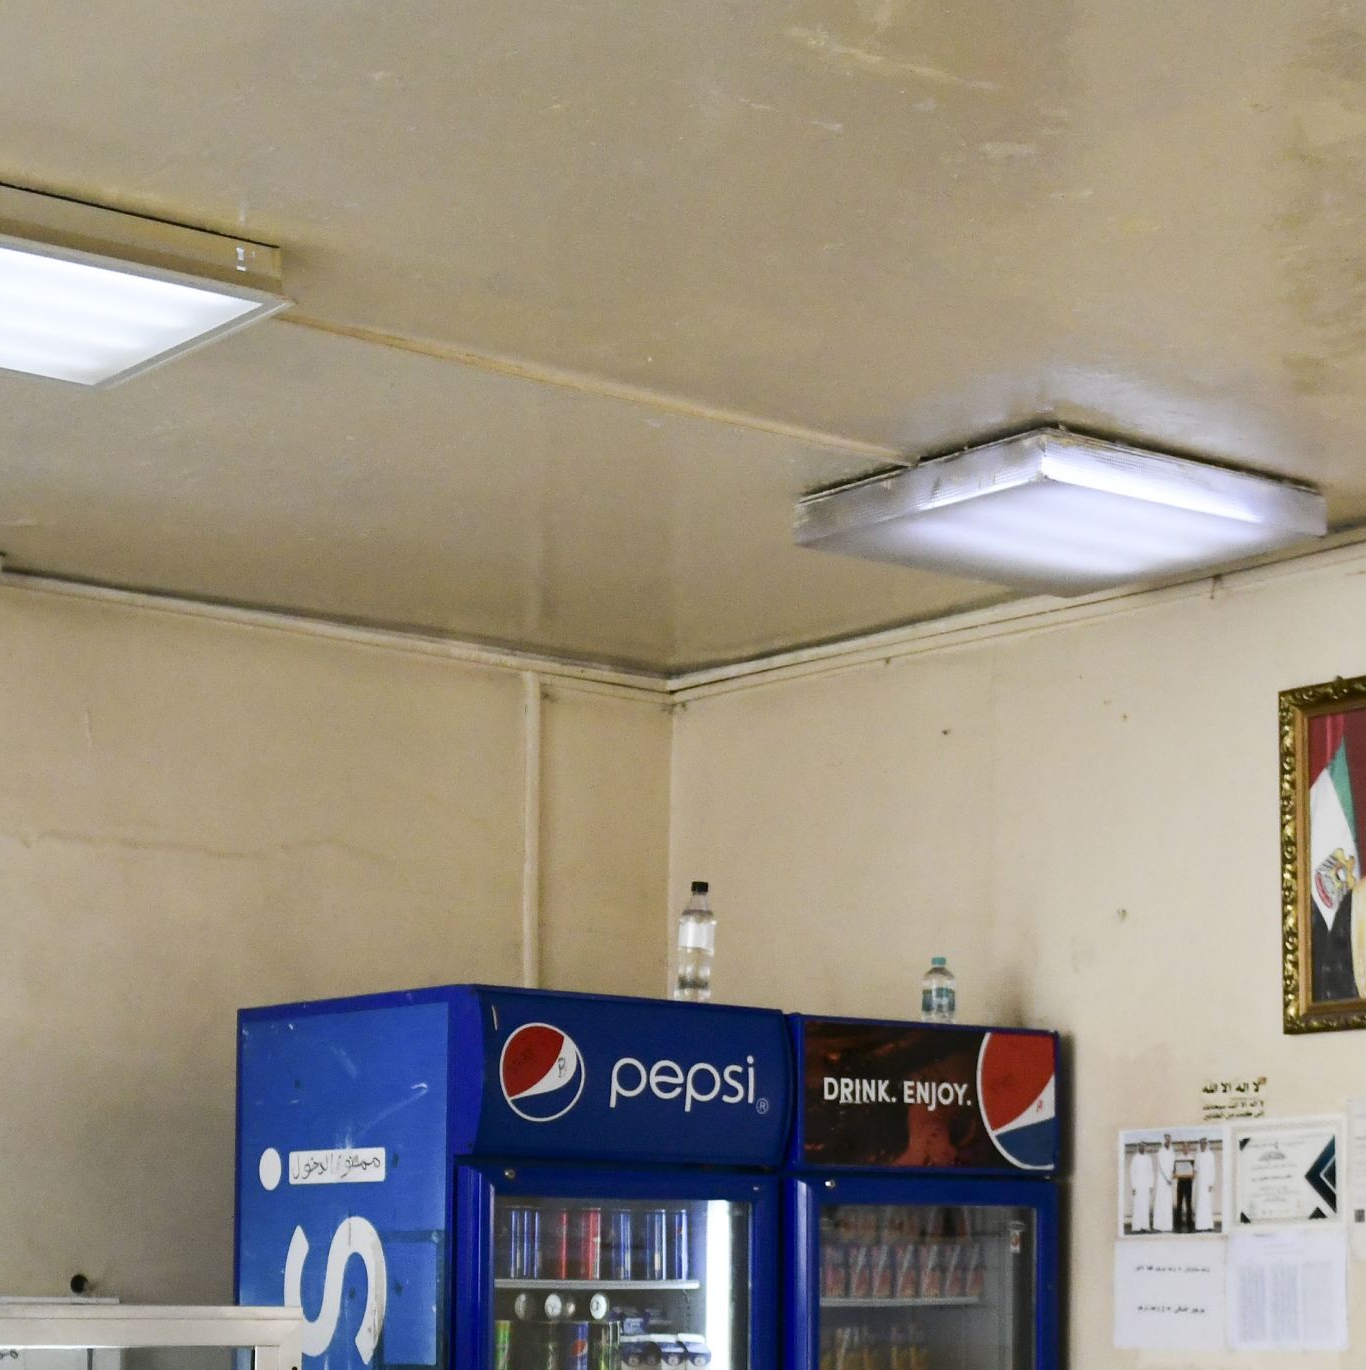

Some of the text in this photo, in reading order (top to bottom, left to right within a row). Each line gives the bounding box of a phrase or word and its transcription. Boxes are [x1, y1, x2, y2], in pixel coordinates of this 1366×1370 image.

[609, 1054, 755, 1113] pepsi
[823, 1076, 972, 1112] DRINK. ENJOY.
